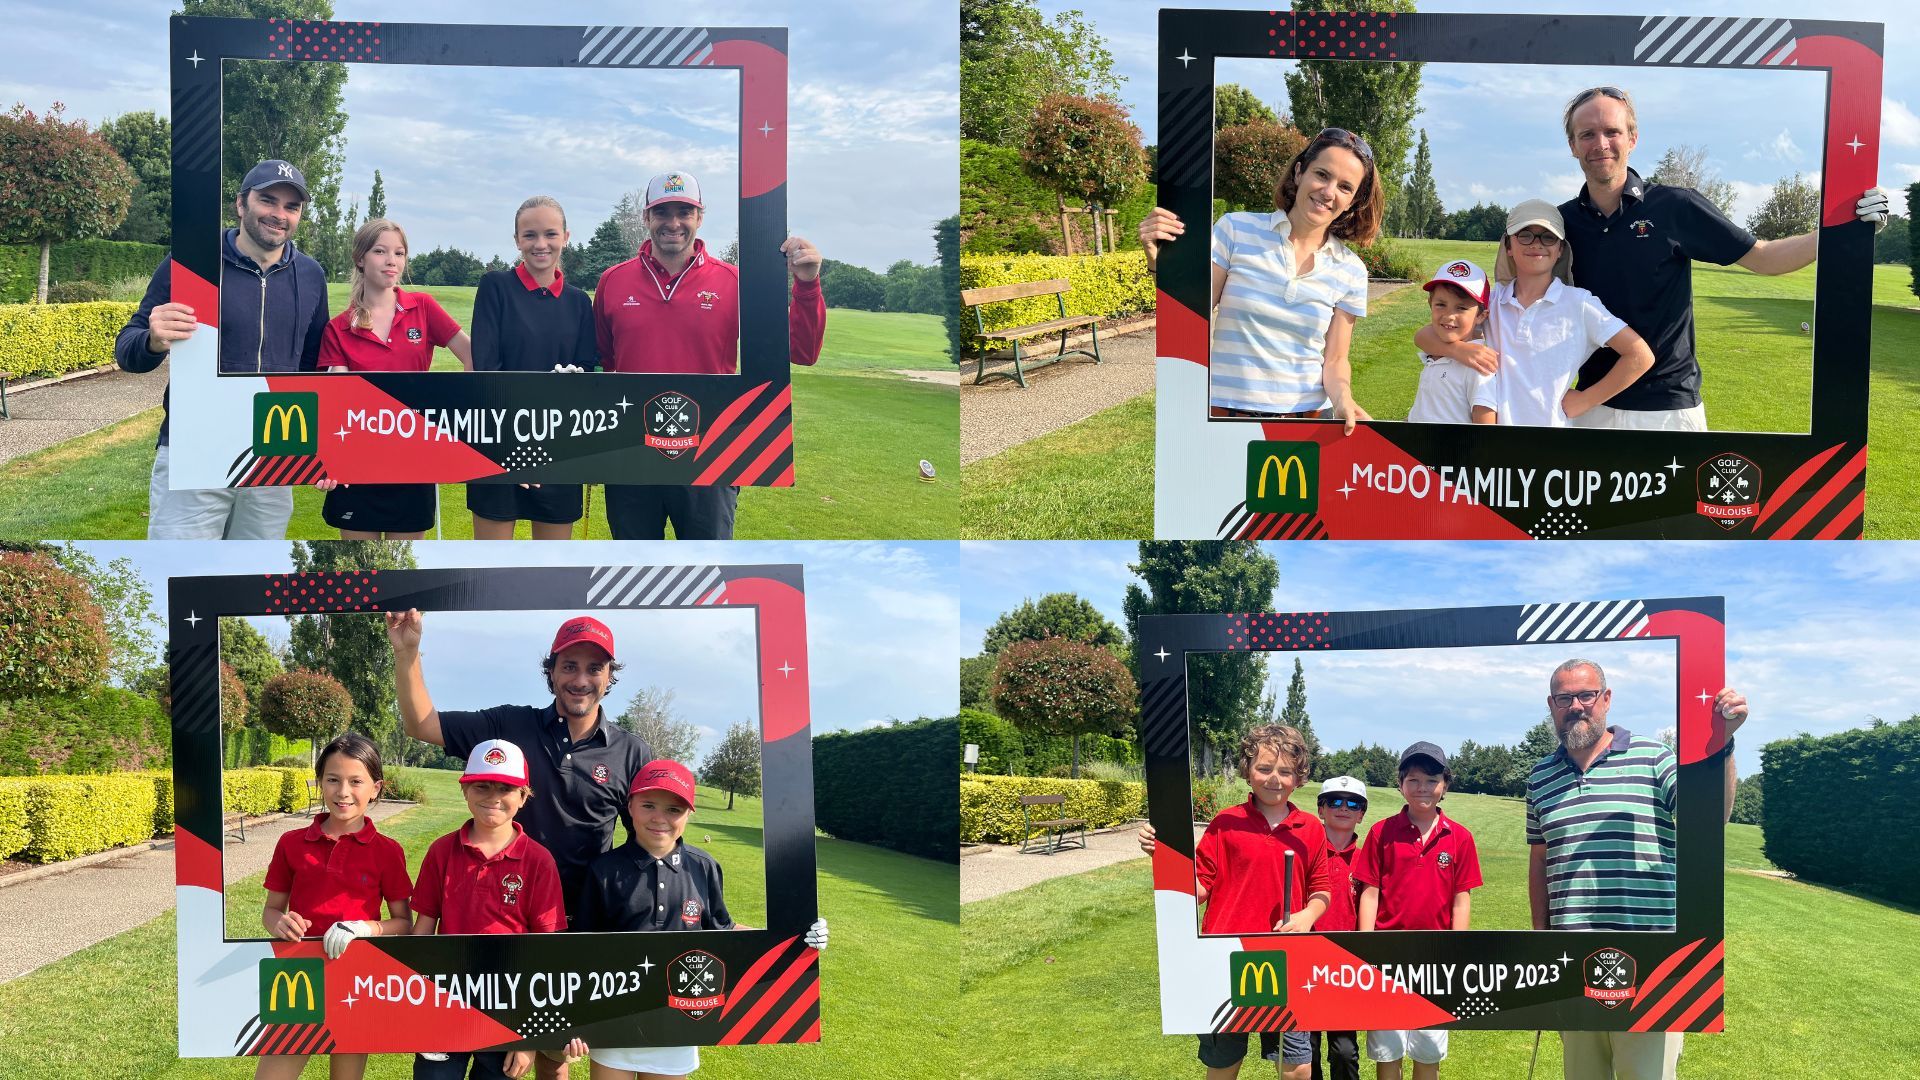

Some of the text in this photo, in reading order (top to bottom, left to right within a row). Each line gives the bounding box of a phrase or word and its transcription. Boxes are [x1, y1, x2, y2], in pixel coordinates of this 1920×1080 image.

[661, 396, 682, 404] GOLF
[423, 408, 507, 444] FAMILY
[513, 408, 563, 443] CUP
[569, 409, 619, 437] 2023
[650, 438, 694, 447] TOULOUSE
[1717, 459, 1742, 467] GOLF
[1439, 466, 1537, 508] FAMILY
[1544, 469, 1602, 508] CUP
[1609, 471, 1668, 503] 2023
[1703, 505, 1753, 516] TOULOUSE
[685, 955, 707, 963] GOLF
[1599, 952, 1620, 960] GOLF
[1381, 963, 1457, 995] FAMILY
[1462, 963, 1508, 994] CUP
[1514, 964, 1560, 990] 2023
[434, 973, 522, 1010] FAMILY
[529, 972, 582, 1008] CUP
[588, 971, 641, 1001] 2023
[1590, 989, 1630, 998] TOULOUSE
[674, 998, 719, 1007] TOULOUSE
